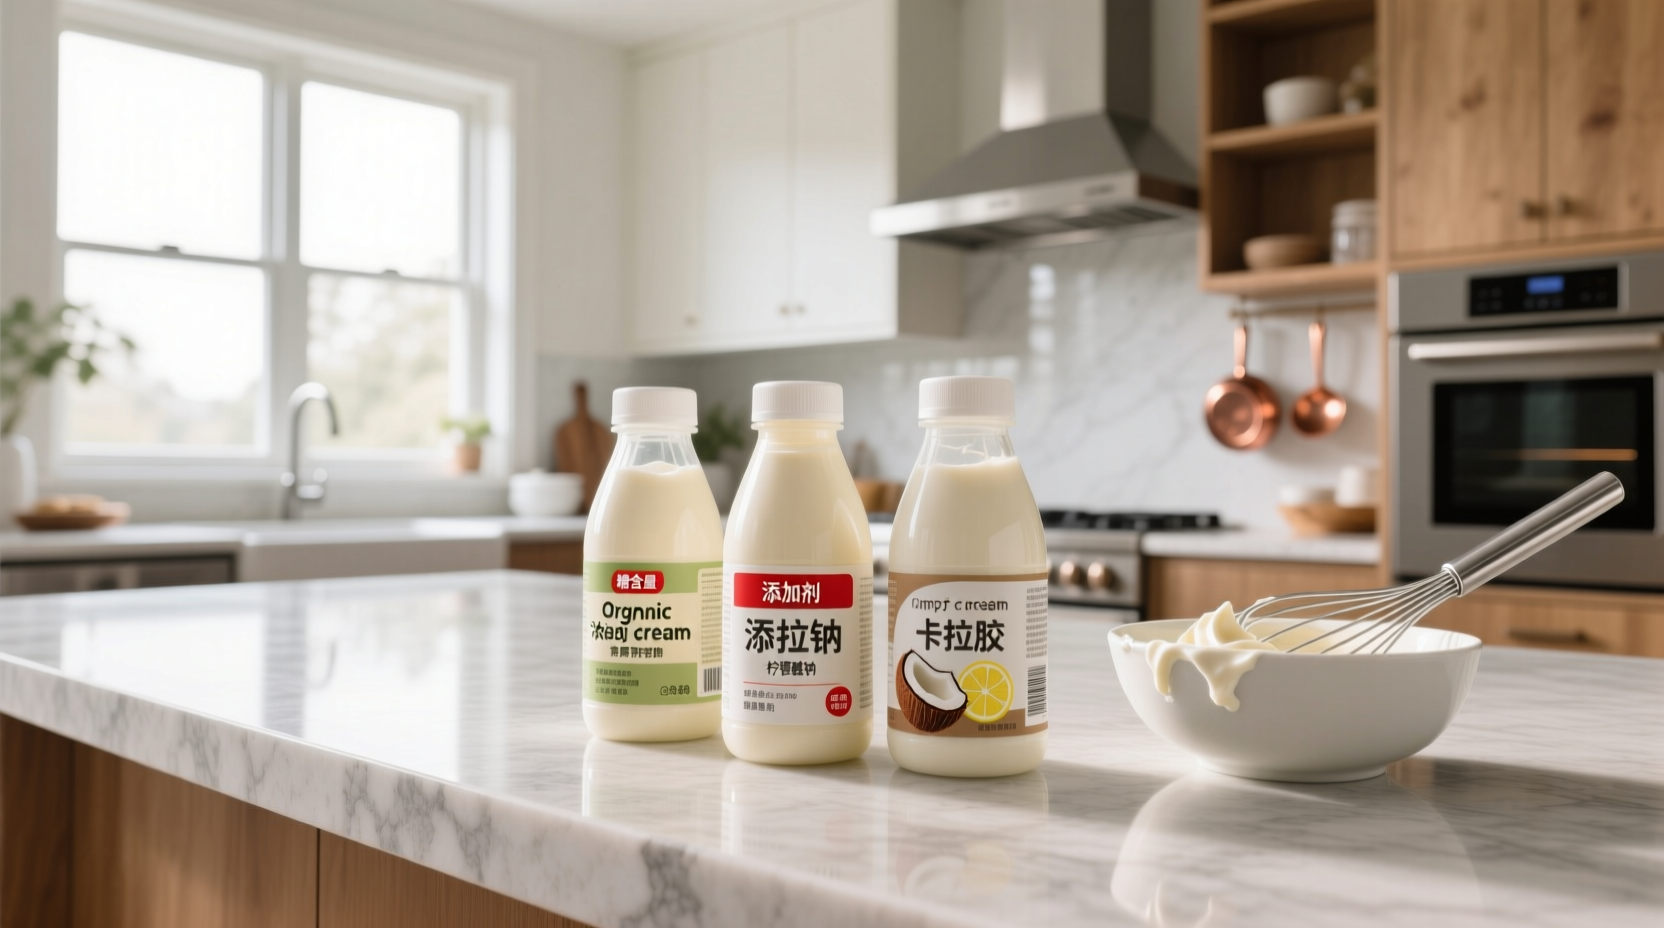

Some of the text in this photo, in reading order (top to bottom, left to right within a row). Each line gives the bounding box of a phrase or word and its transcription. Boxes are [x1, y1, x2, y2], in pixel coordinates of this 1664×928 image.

[761, 580, 820, 604] 添加剂
[633, 626, 691, 641] cream
[745, 617, 842, 655] 添拉钠
[916, 618, 1005, 652] 卡拉胶
